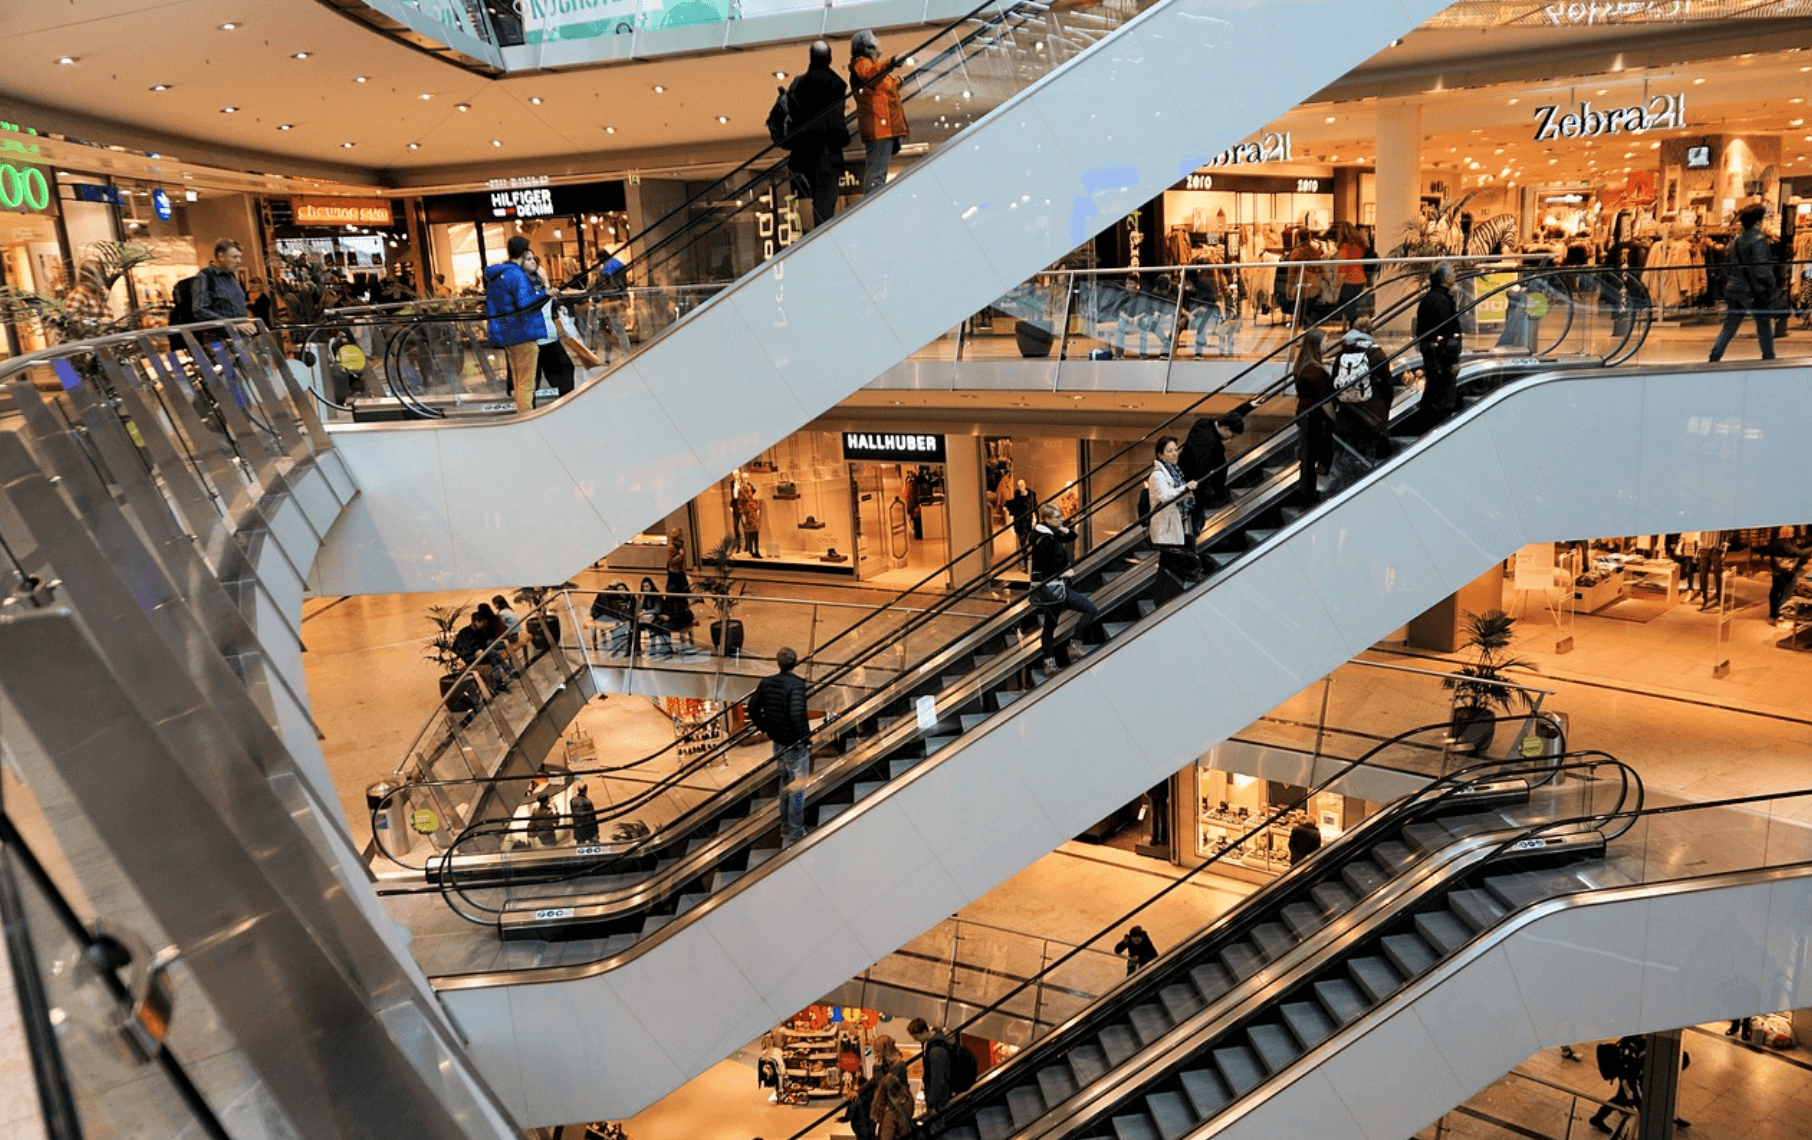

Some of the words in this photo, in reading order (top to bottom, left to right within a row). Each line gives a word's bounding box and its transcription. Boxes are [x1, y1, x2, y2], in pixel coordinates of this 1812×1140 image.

[1533, 92, 1687, 141] Zebra21
[1186, 174, 1213, 190] zero
[1296, 178, 1319, 193] zero
[490, 188, 552, 208] HILFIGER
[516, 203, 554, 218] DENIM
[847, 433, 937, 452] HALLHUBER
